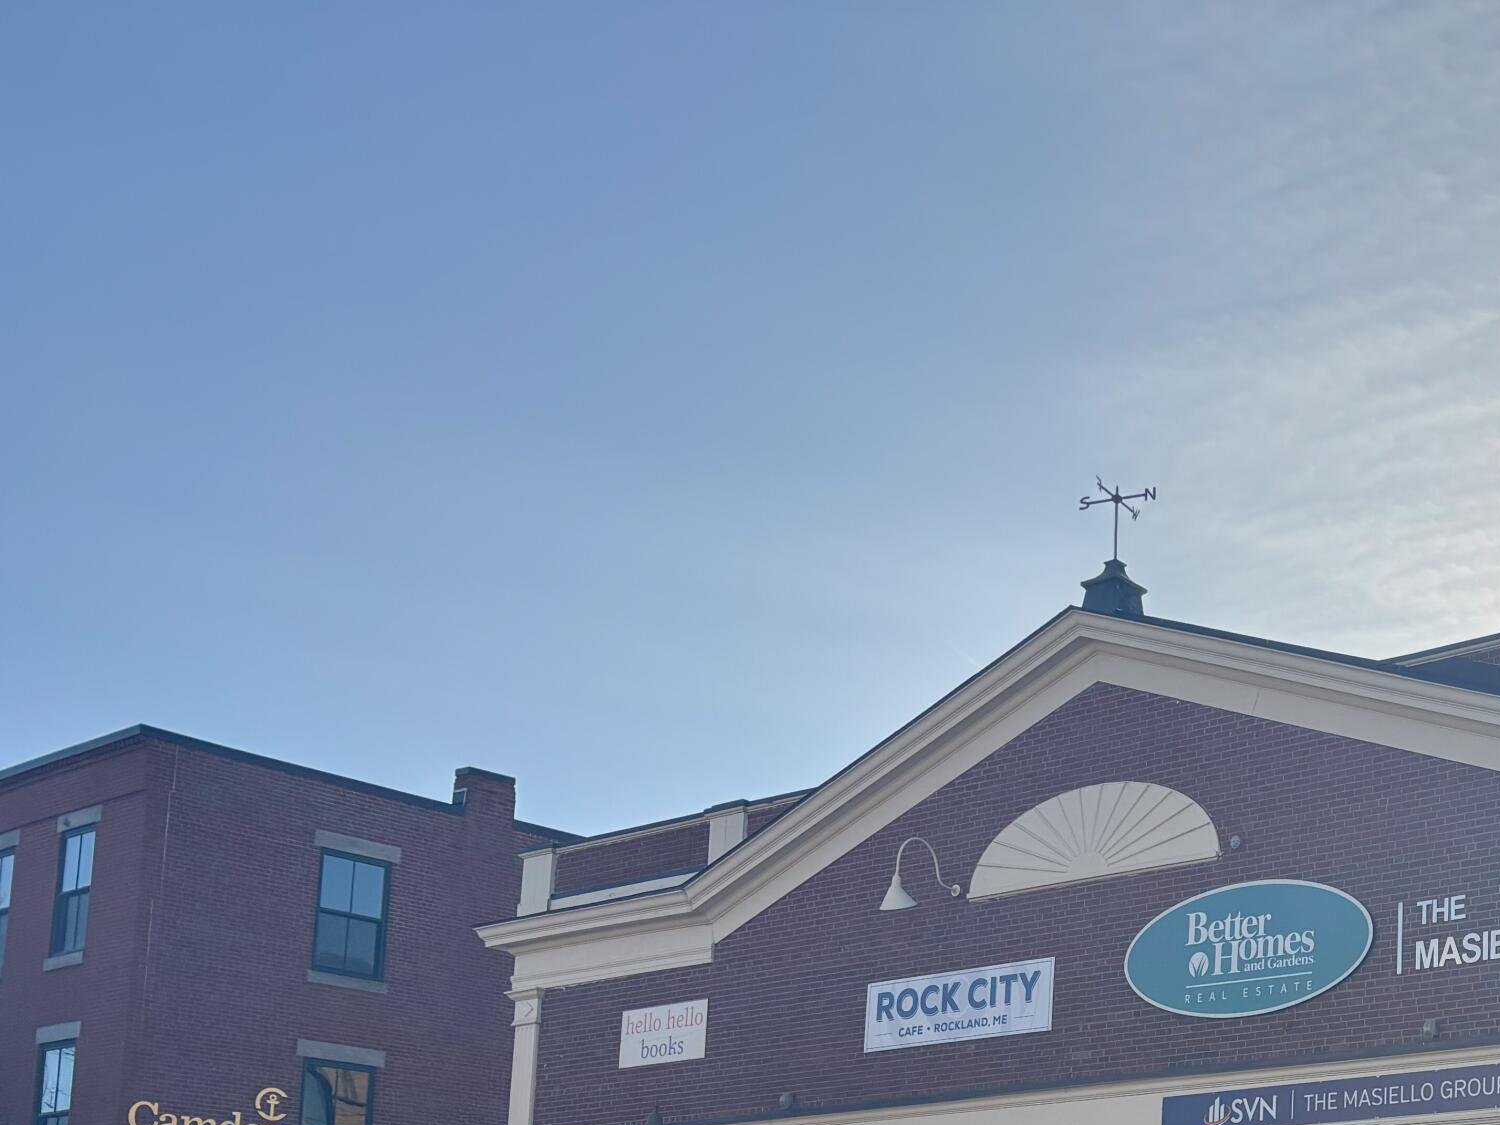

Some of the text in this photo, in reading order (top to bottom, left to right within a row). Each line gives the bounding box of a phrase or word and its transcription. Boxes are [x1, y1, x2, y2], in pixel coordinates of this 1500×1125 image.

[1417, 894, 1466, 925] THE
[1185, 911, 1272, 946] Better
[1211, 930, 1315, 976] Homes
[1244, 954, 1314, 972] and Gardens
[876, 970, 1042, 1023] ROCK CITY
[1184, 980, 1313, 1004] REAL ESTATE
[625, 1006, 704, 1035] hello hello
[898, 1014, 1008, 1037] CAFE ROCKLAND, ME
[640, 1035, 684, 1059] books
[1230, 1095, 1278, 1124] SVN
[1304, 1092, 1338, 1112] THE
[1344, 1082, 1434, 1109] MASIELLO
